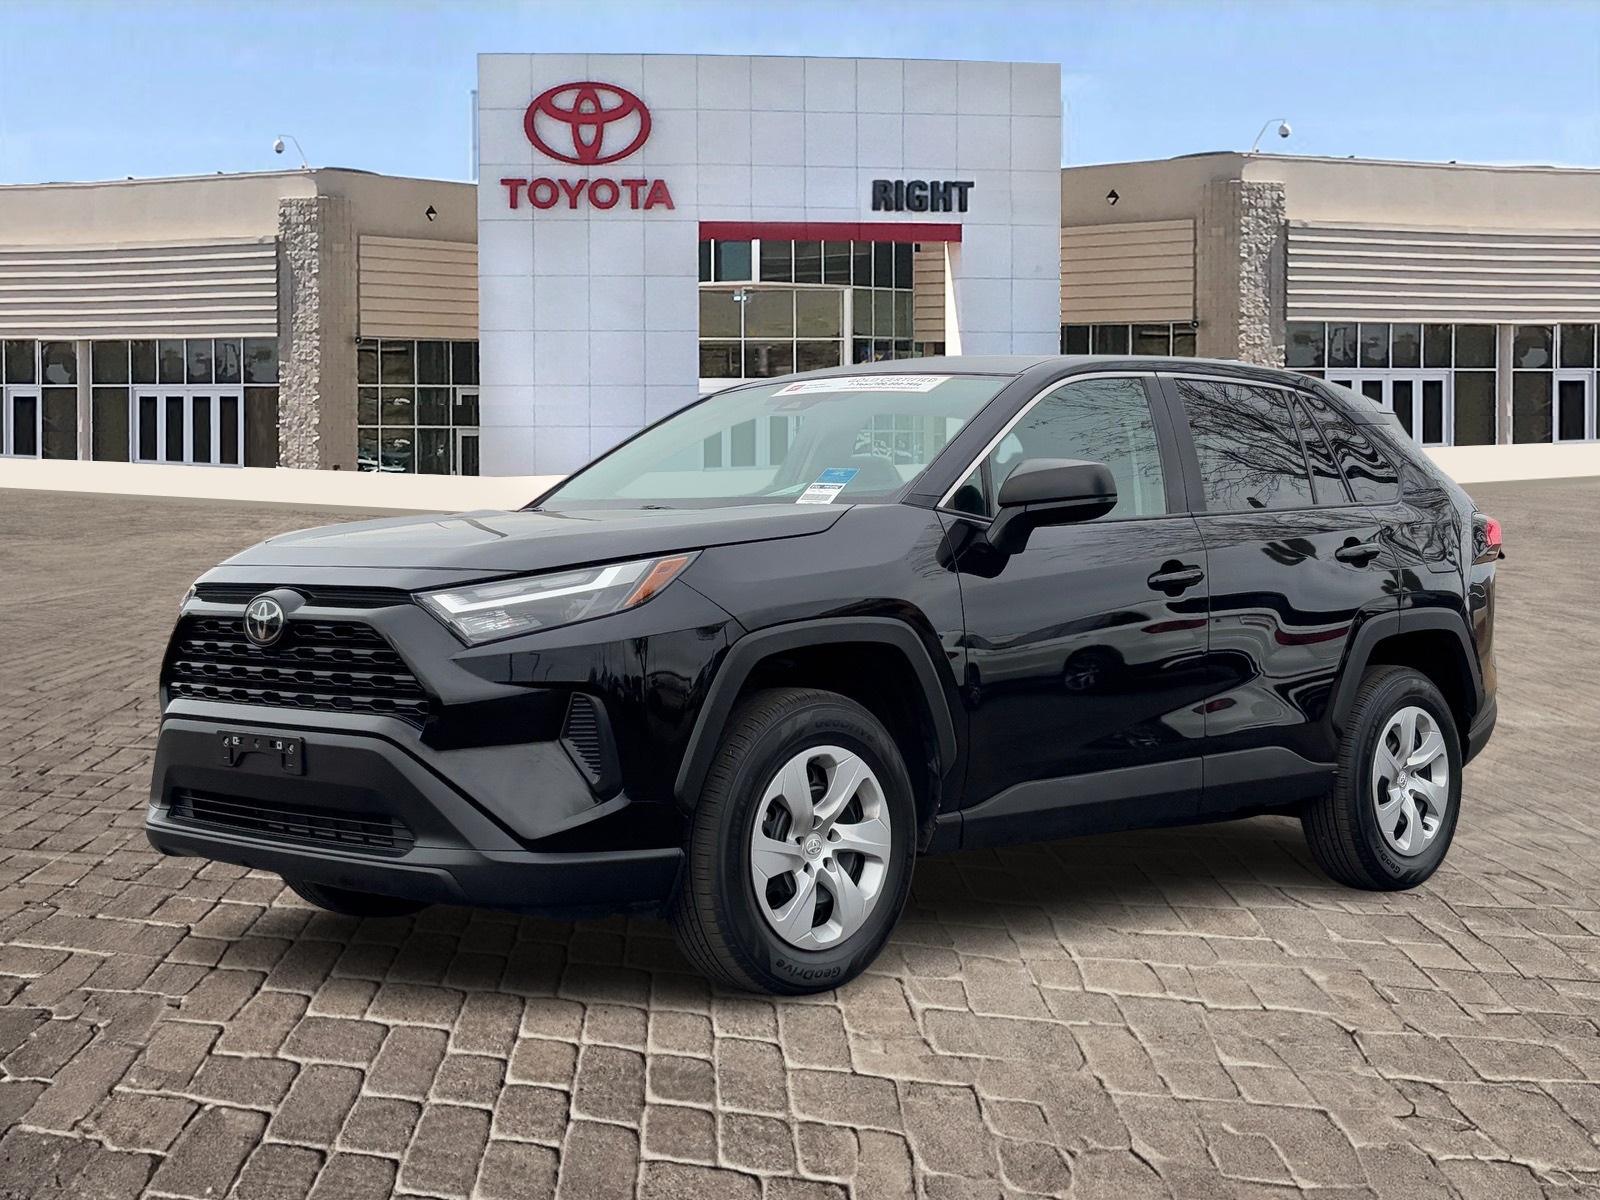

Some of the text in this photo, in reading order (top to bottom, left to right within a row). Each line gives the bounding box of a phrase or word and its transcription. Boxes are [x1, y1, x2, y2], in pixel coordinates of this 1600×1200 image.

[500, 178, 675, 209] TOYOTA
[872, 180, 974, 212] RIGHT
[776, 959, 841, 980] GeoDrive
